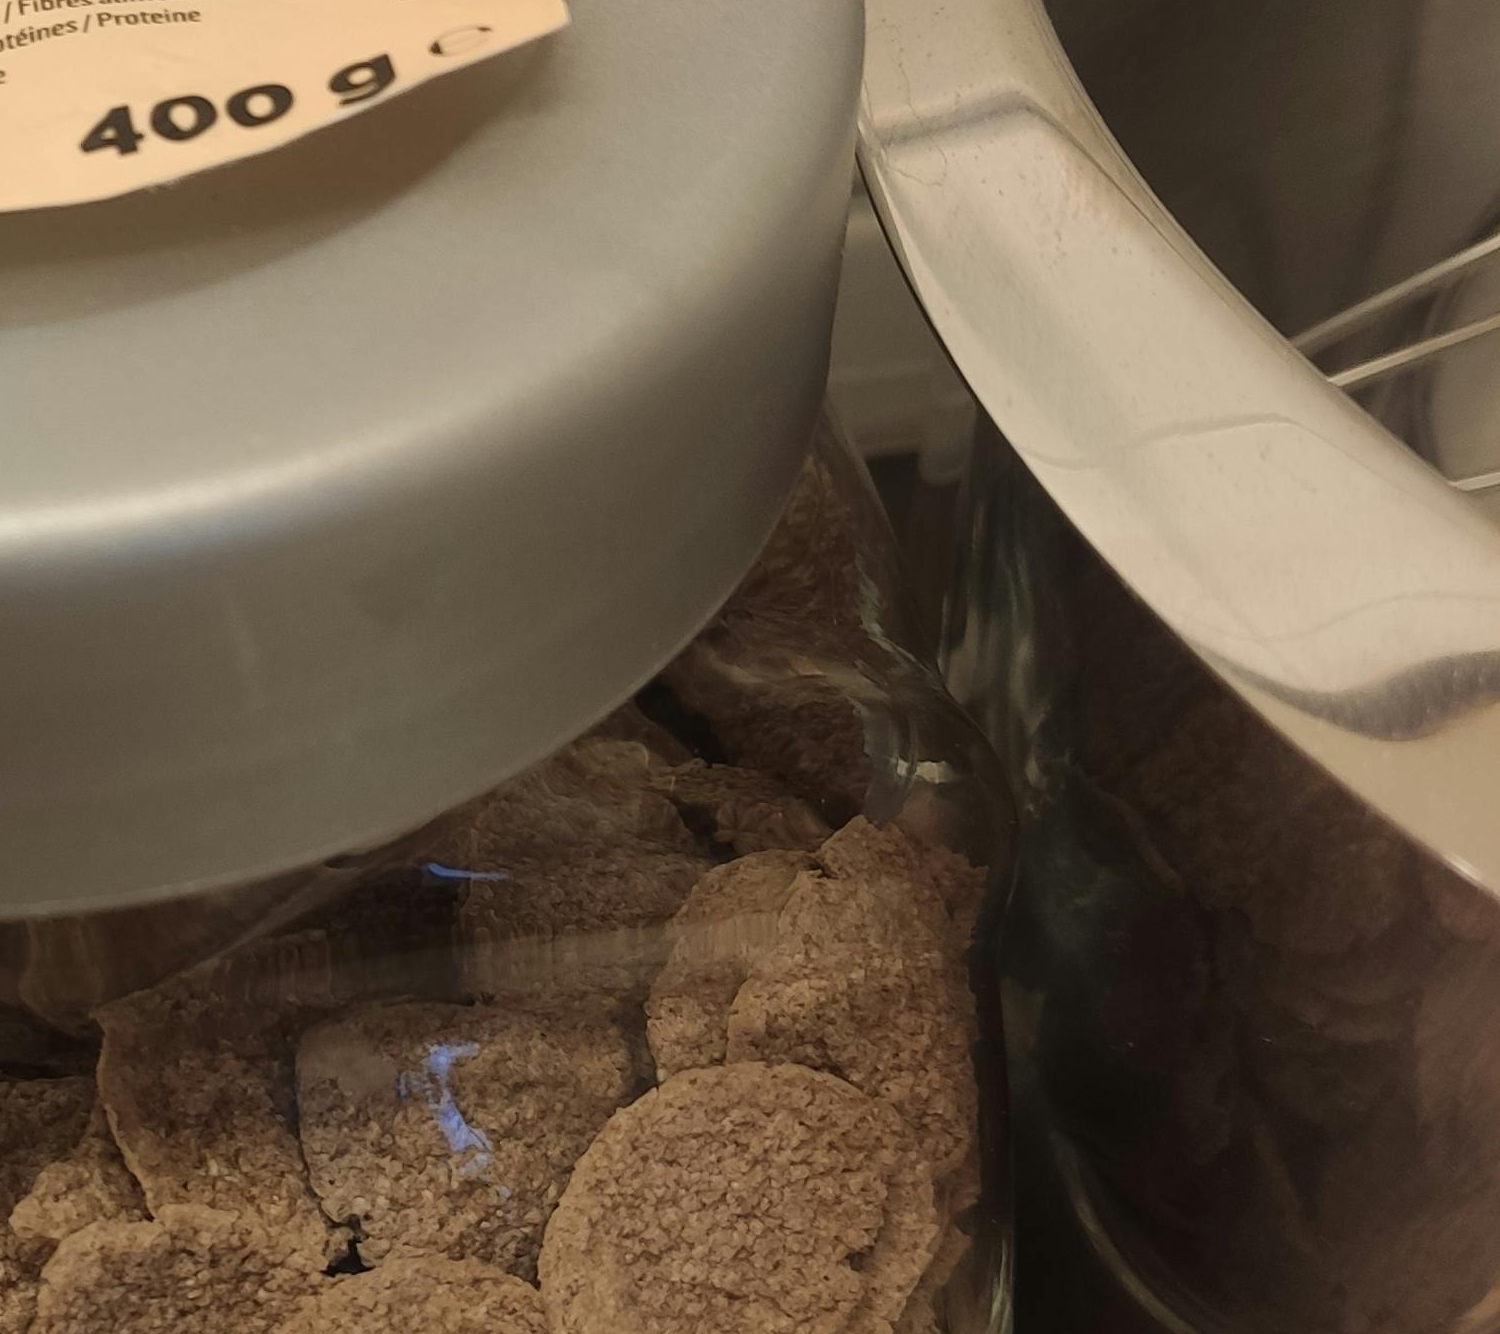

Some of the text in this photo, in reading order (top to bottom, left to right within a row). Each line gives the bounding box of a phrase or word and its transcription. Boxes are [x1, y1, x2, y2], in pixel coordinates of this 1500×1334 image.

[96, 7, 201, 28] Proteine
[80, 54, 396, 156] 400 g
